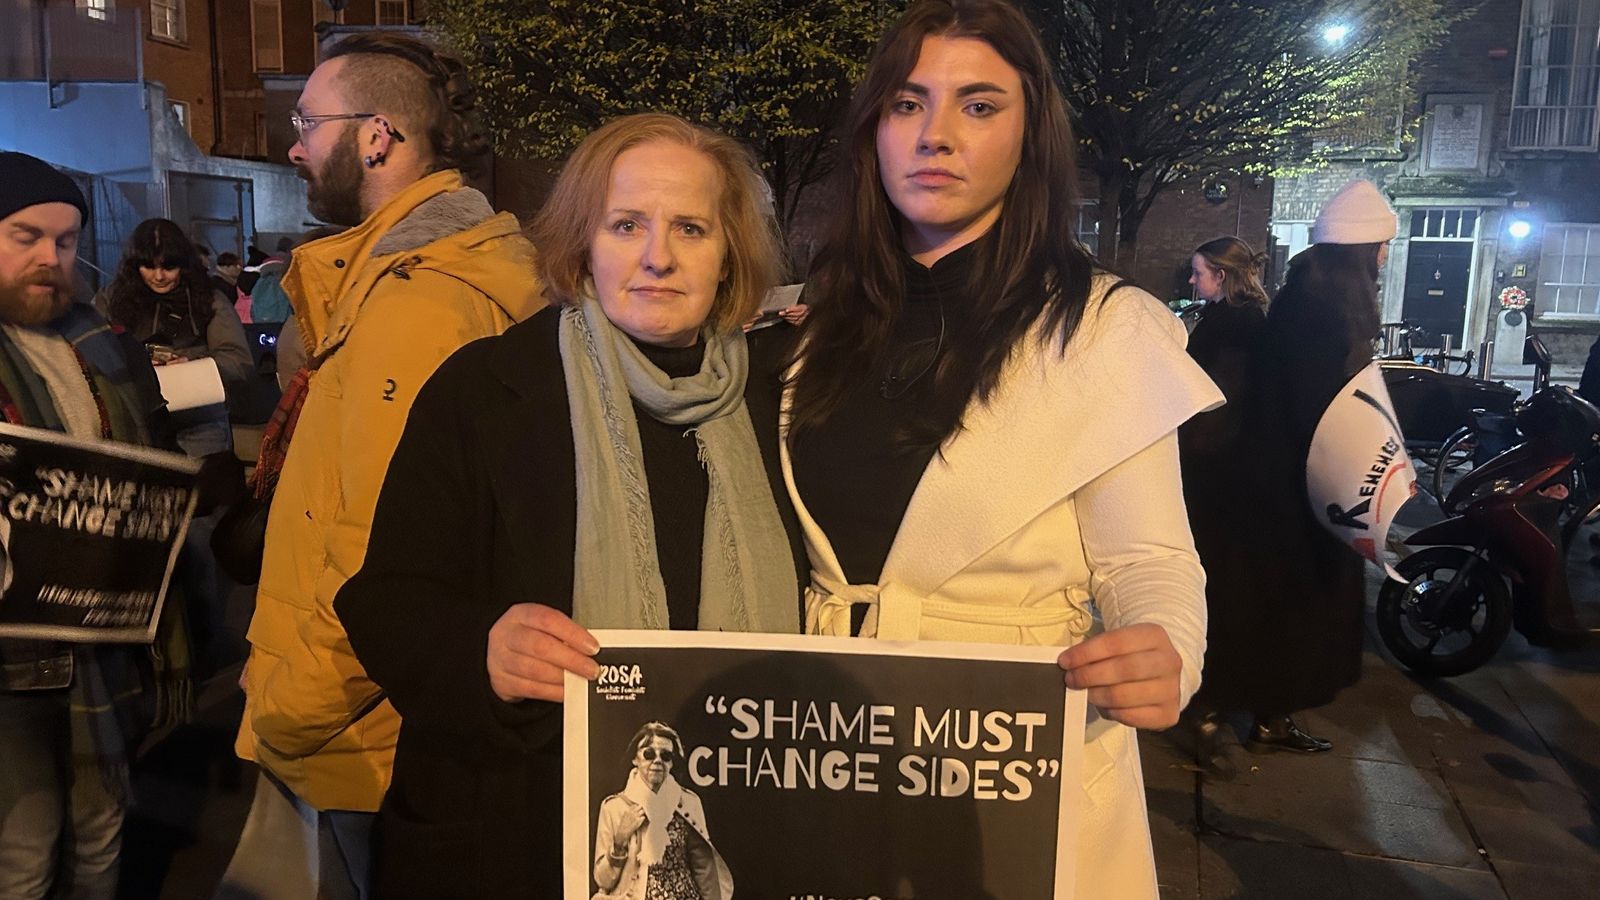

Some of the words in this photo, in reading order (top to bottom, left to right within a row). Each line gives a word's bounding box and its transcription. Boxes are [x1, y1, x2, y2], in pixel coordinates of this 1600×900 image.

[8, 491, 122, 537] CHANGE
[598, 664, 643, 686] ROSA
[705, 696, 895, 745] “SHAME
[914, 706, 1047, 753] MUST
[688, 745, 880, 793] CHANGE
[897, 754, 1060, 801] SIDES”
